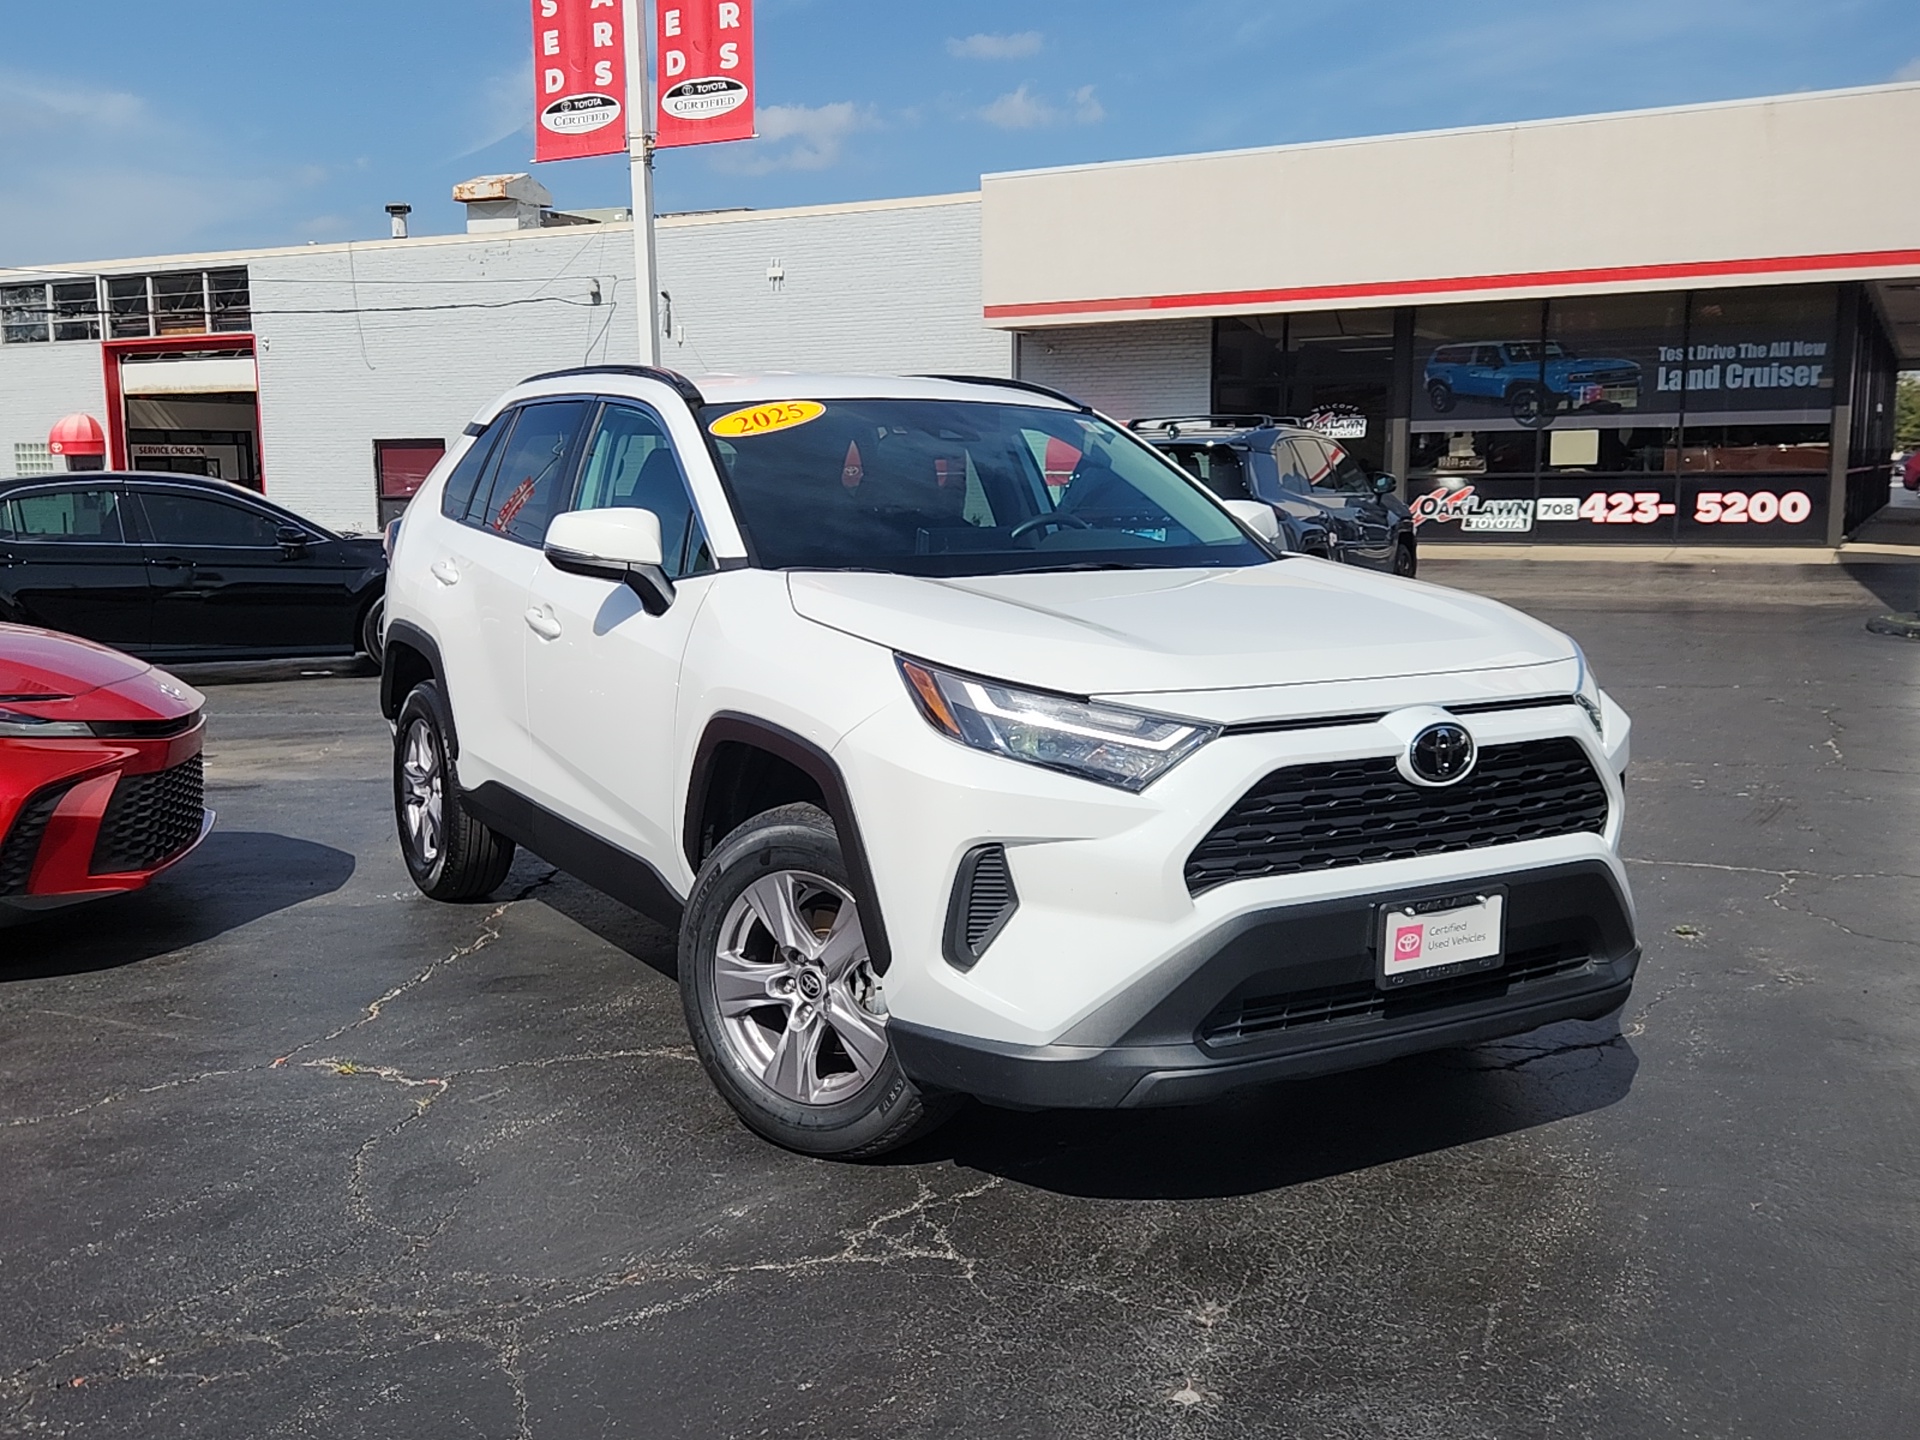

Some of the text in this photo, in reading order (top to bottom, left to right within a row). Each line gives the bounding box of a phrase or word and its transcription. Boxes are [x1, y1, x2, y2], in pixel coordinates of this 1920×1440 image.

[697, 81, 728, 94] TOYOTA
[573, 98, 603, 110] TOYOTA
[674, 96, 736, 112] CERTIFIED
[553, 111, 610, 127] CERTIFIED
[1658, 341, 1827, 362] Test Drive The All New
[1656, 362, 1823, 391] Land Cruiser
[733, 403, 805, 433] 2025
[138, 445, 170, 455] SERVICE
[1541, 491, 1812, 523] 708 423- 5200
[1470, 517, 1525, 530] TOYOTA
[1429, 921, 1468, 937] Certified
[1428, 932, 1487, 951] Used Vehicles
